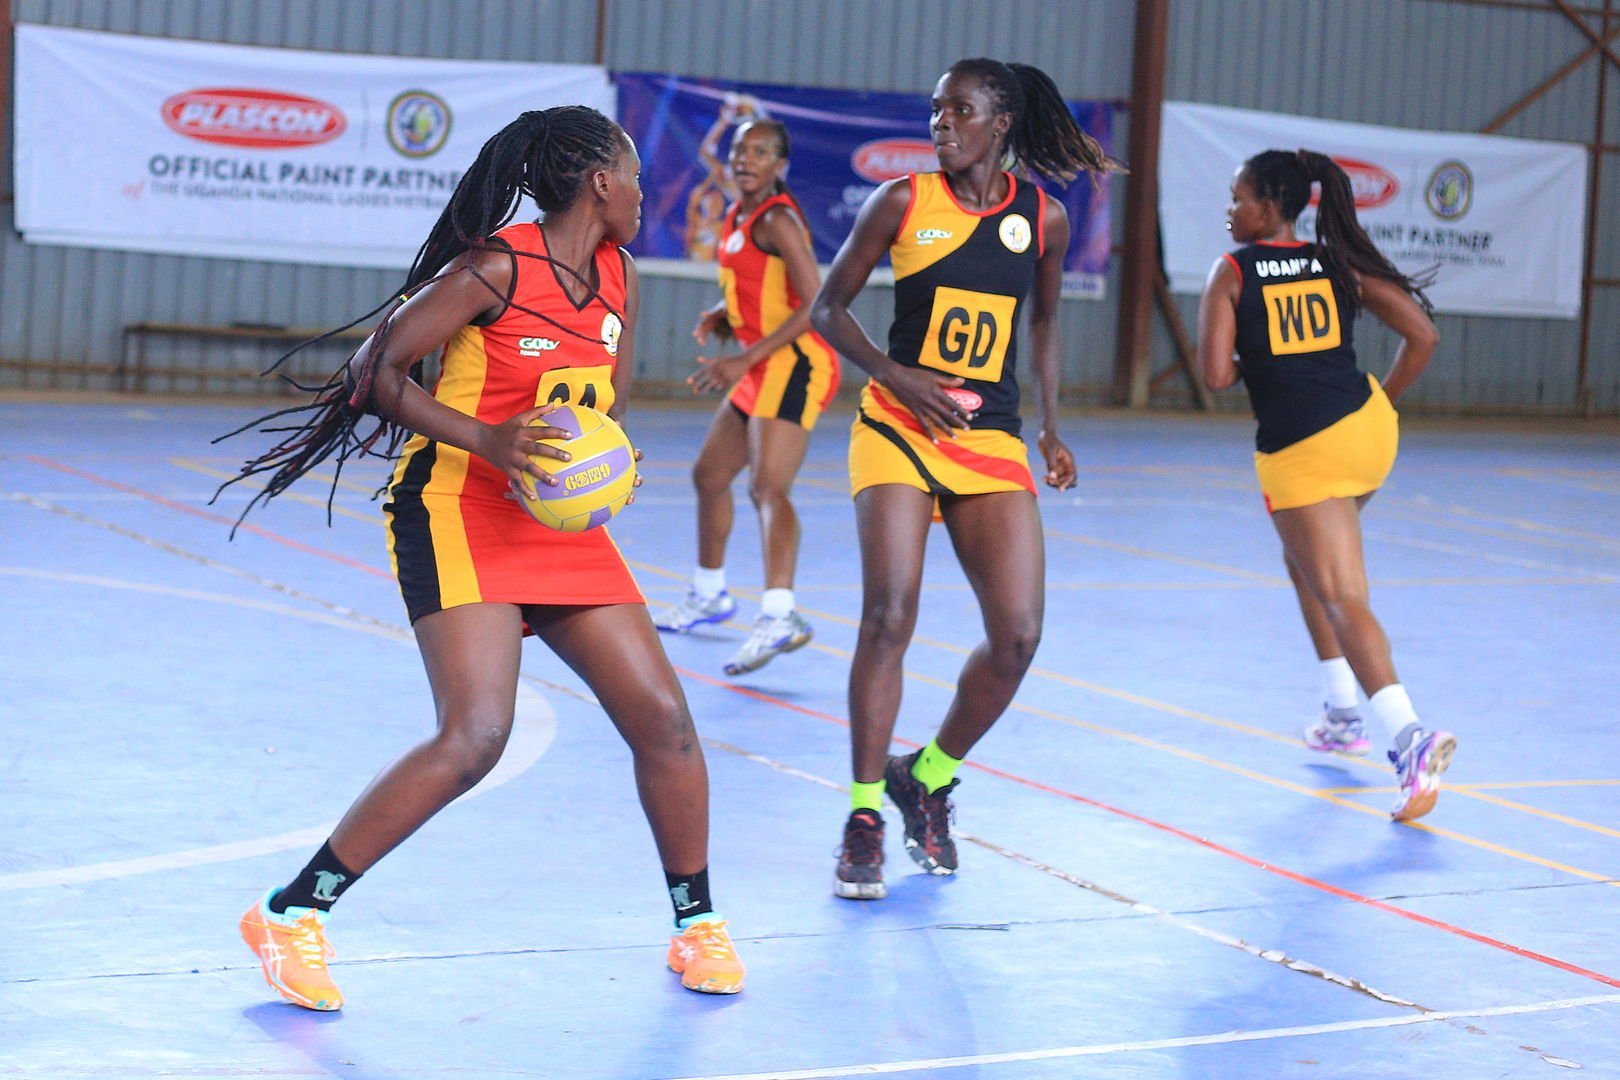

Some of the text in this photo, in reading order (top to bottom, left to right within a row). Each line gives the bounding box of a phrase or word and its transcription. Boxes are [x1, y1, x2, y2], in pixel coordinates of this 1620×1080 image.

[177, 100, 330, 135] PLASCON
[148, 154, 463, 193] OFFICIAL PAINT PARTNE
[1410, 226, 1493, 251] PARTNER
[938, 306, 998, 369] GD
[1274, 293, 1331, 343] WD
